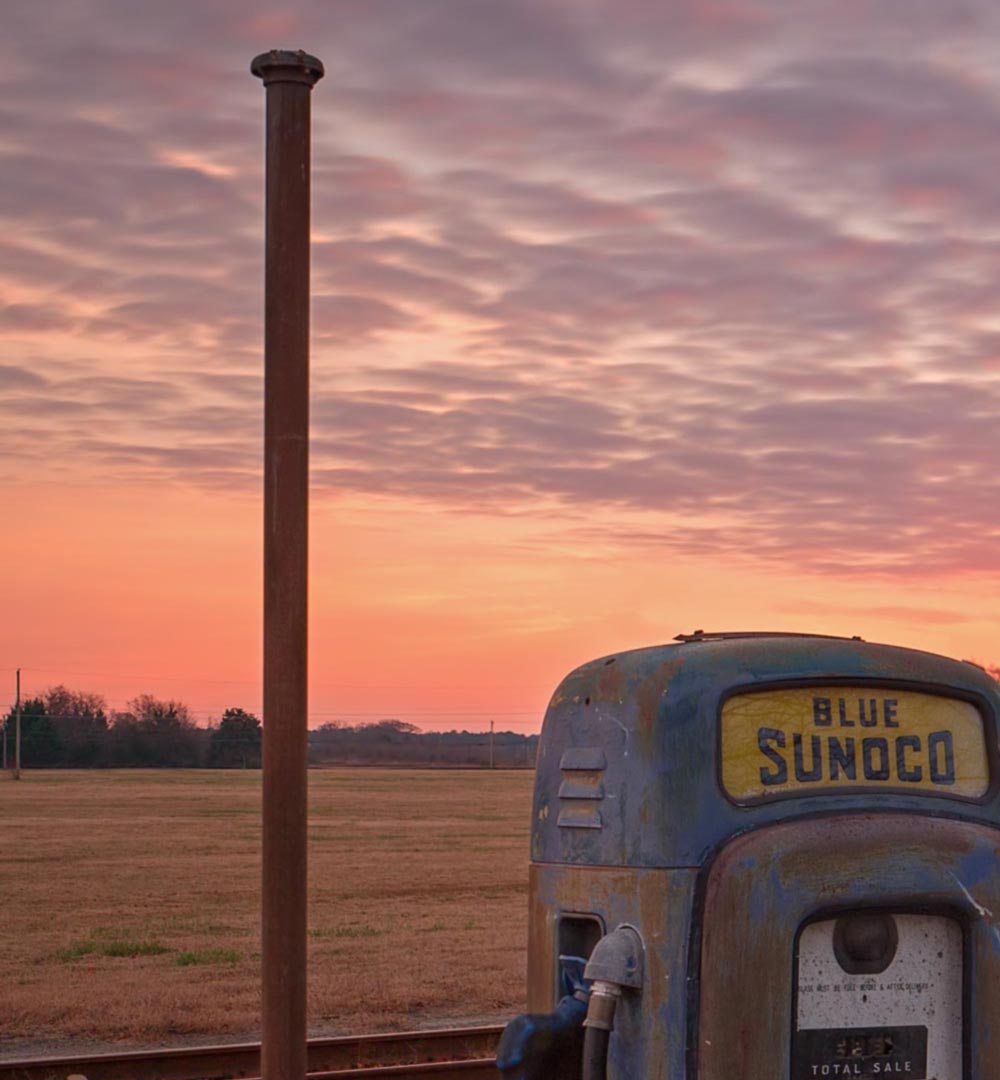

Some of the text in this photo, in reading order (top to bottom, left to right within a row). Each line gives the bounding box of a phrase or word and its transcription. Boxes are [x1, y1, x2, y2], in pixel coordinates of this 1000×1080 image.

[812, 697, 899, 728] BLUE
[757, 726, 956, 786] SUNOCO
[811, 1061, 911, 1075] TOTAL SALE
